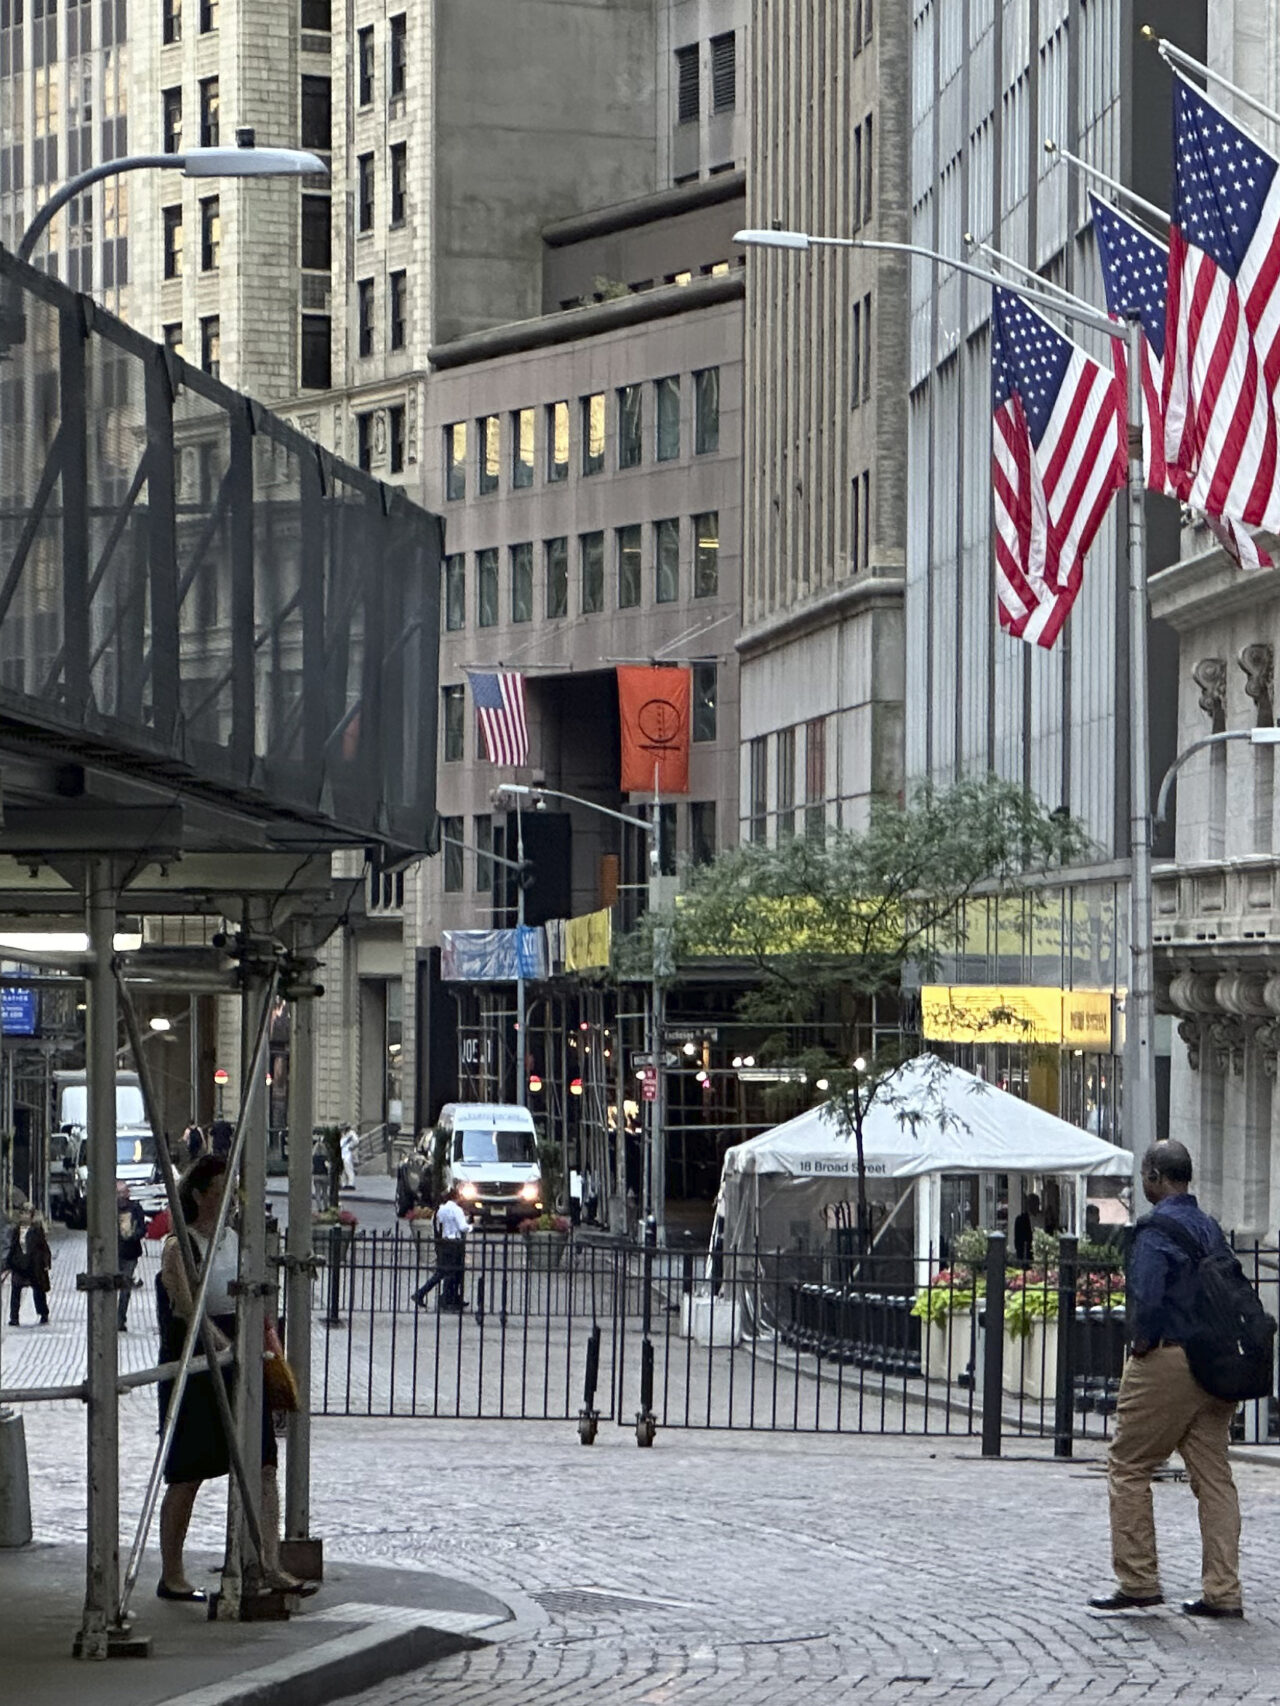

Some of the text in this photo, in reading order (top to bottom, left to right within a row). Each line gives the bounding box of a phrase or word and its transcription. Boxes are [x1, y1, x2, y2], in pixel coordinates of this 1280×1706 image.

[801, 1161, 886, 1174] 18 Broad Sreet
